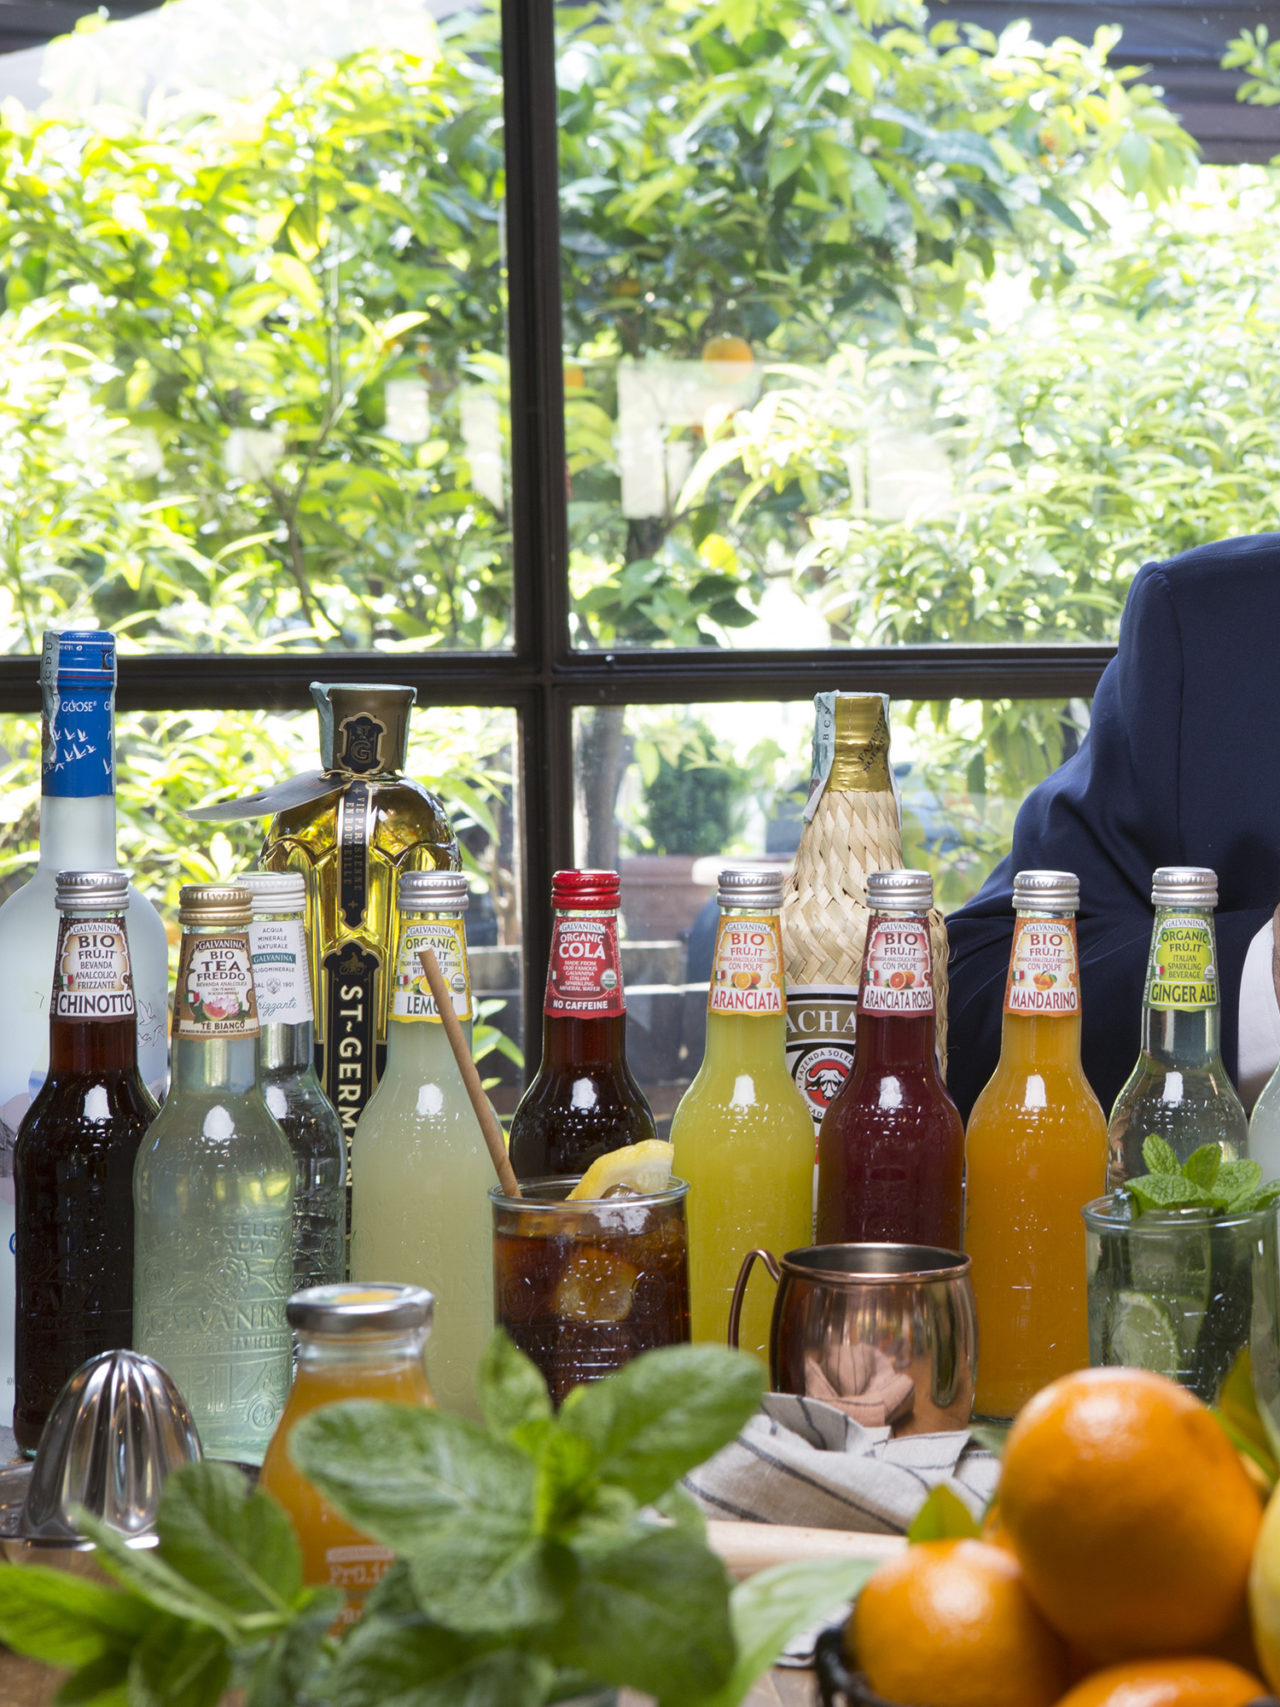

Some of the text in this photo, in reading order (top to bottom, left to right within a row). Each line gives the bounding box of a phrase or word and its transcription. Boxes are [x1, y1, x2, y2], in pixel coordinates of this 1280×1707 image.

[346, 801, 355, 814] EN
[356, 797, 365, 813] VIE
[73, 924, 117, 934] GALVANINA
[410, 925, 451, 935] GALVANINA
[561, 922, 602, 931] GALVANINA
[727, 922, 768, 931] GALVANINA
[881, 923, 920, 932] GALVANINA
[1026, 923, 1065, 932] GALVANINA
[78, 935, 115, 949] BIO
[560, 932, 605, 944] ORGANIC
[731, 932, 765, 946] BIO
[884, 933, 918, 946] BIO
[1030, 933, 1063, 947] BIO
[1161, 930, 1209, 944] ORGANIC
[198, 940, 243, 950] GALVANINA
[210, 950, 235, 960] BIO
[558, 942, 606, 960] COLA
[253, 954, 293, 963] GALVANINA
[1172, 954, 1197, 962] ITALIAN
[80, 961, 113, 970] BEVANDA
[201, 960, 242, 972] TEA
[728, 962, 763, 971] CON POLPE
[882, 962, 918, 971] CON POLPE
[1027, 962, 1062, 971] CON POLPE
[1167, 962, 1202, 970] SPARKLING
[75, 971, 118, 980] ANALCOLICA
[196, 972, 246, 982] FREDDO
[1168, 971, 1201, 979] BEVERAGE
[77, 981, 116, 990] FRIZZANTE
[1151, 983, 1216, 1003] GINGER ALE
[59, 993, 133, 1014] CHINOTTO
[553, 999, 608, 1010] NO CAFFEINE
[713, 990, 780, 1010] ARANCIATA
[865, 990, 932, 1009] ARANCIATA ROSSA
[1011, 990, 1076, 1009] MANDARINO
[214, 1021, 246, 1030] BIANCO
[786, 1010, 857, 1034] ACHA
[797, 1050, 825, 1082] FAZENDA
